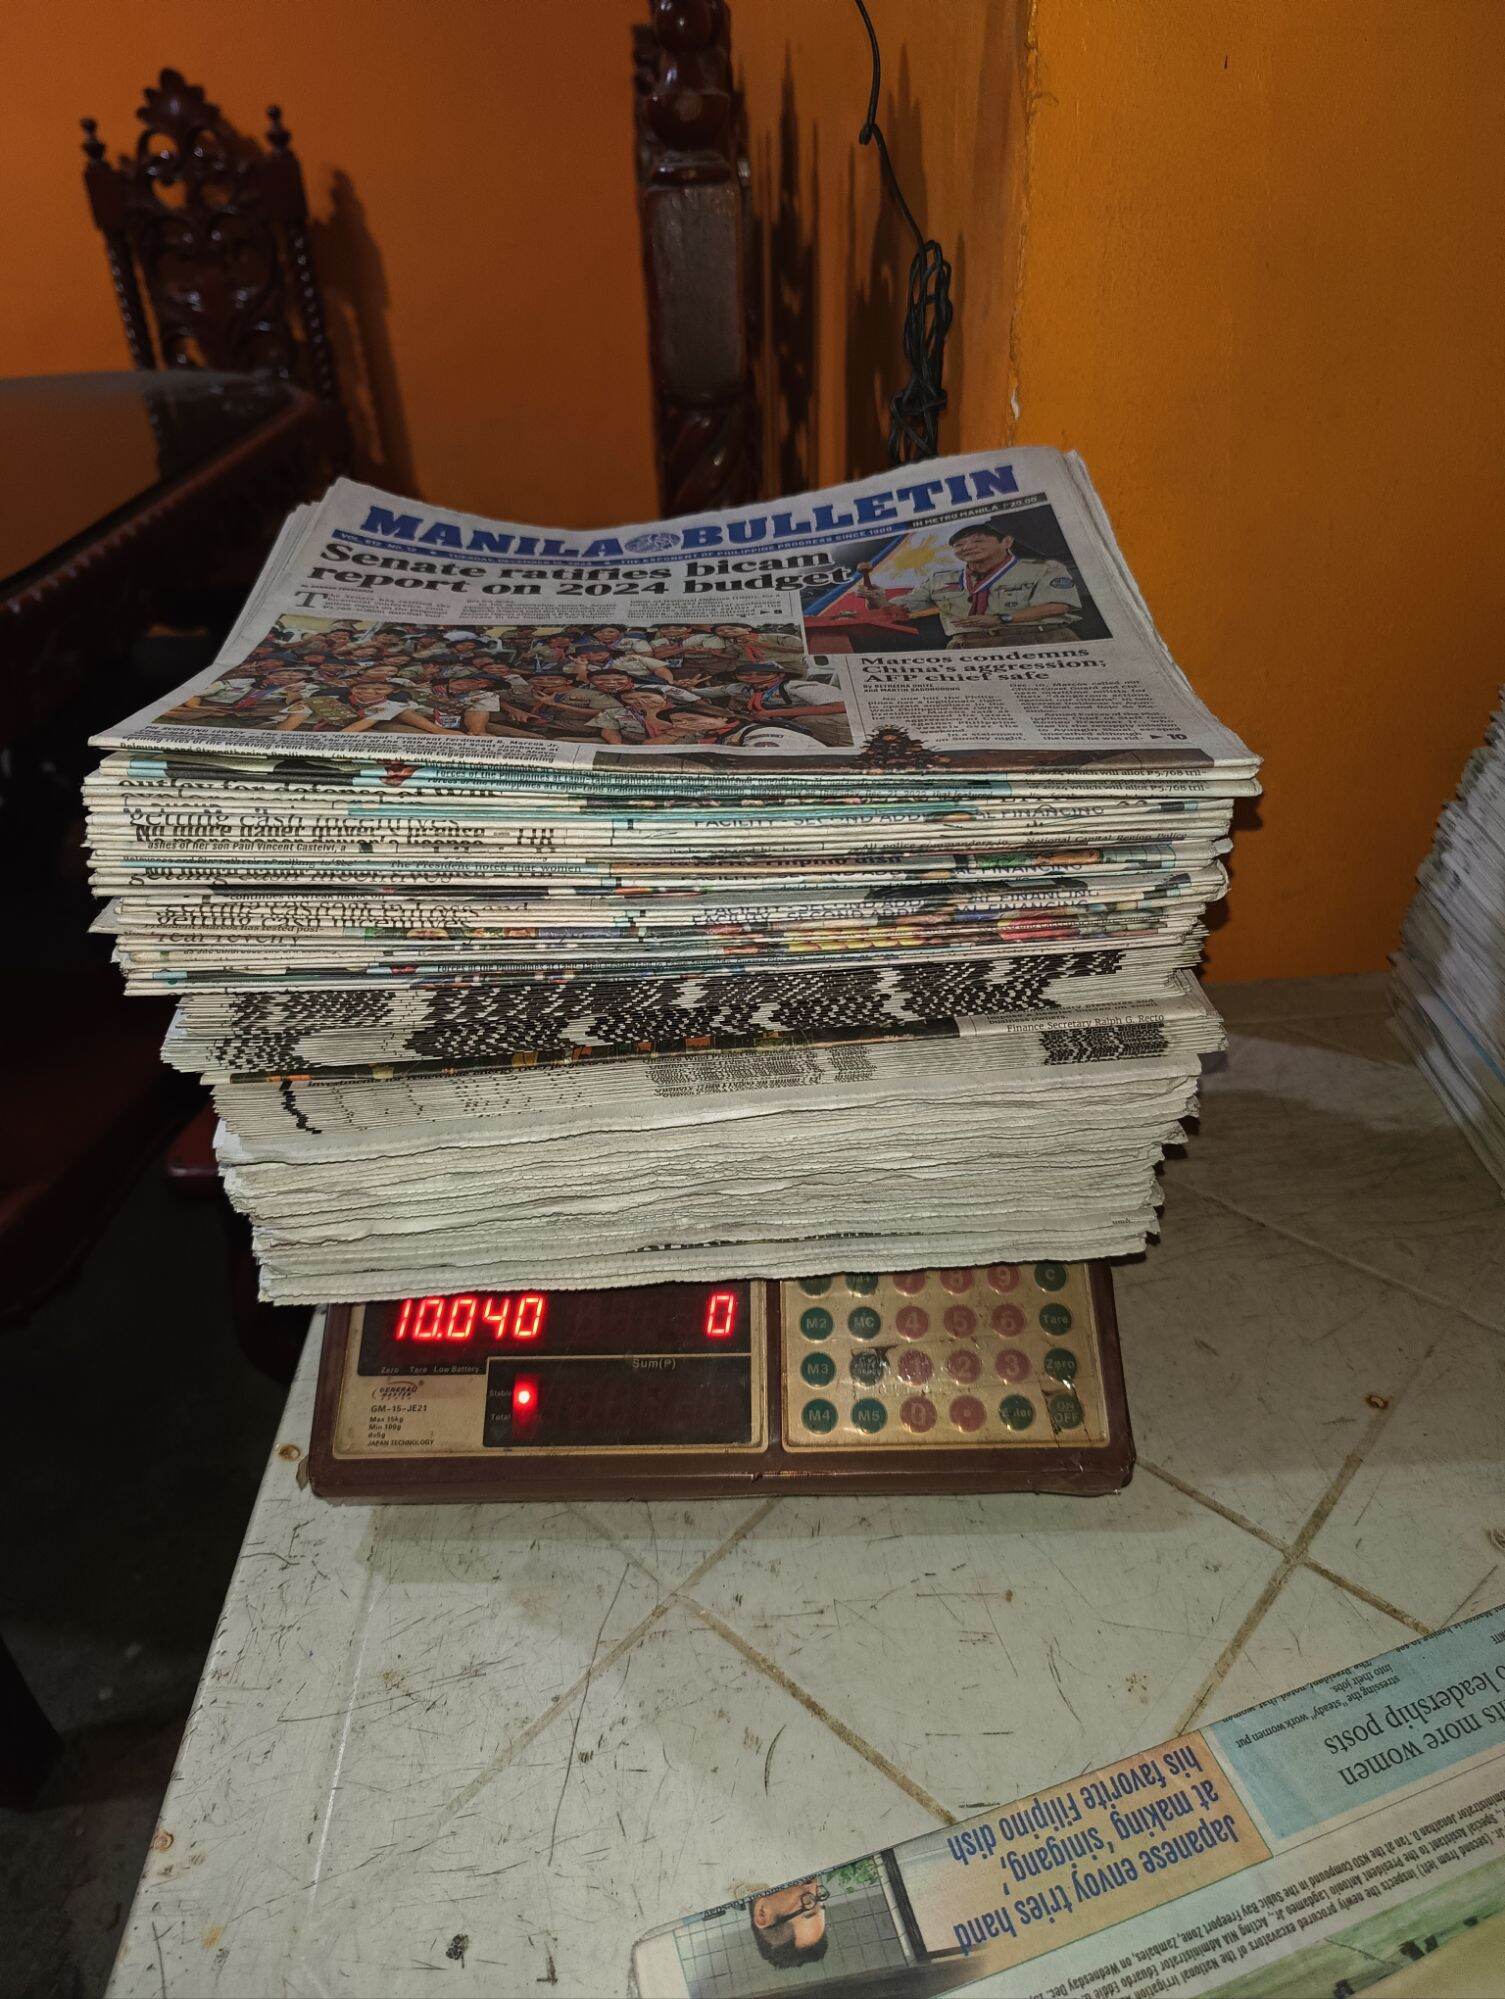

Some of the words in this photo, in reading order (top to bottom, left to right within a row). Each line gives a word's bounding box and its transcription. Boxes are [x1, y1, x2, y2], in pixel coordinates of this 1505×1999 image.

[361, 506, 623, 558] MANILA
[681, 465, 1018, 550] BULLETIN
[925, 513, 958, 526] METRO
[960, 504, 998, 518] MANILA
[717, 545, 775, 557] PHILIPPINE
[778, 537, 832, 550] PROGRESS
[320, 543, 487, 577] Senate
[500, 567, 671, 581] ratifies
[686, 552, 833, 577] bicam
[308, 566, 470, 592] report
[482, 584, 542, 595] on
[556, 581, 668, 597] 2024
[683, 567, 853, 593] budget
[861, 656, 952, 665] Marcos
[959, 648, 1089, 662] condemns
[862, 664, 957, 673] China's
[963, 659, 1106, 673] aggression;
[866, 674, 917, 682] AFP
[925, 672, 992, 681] chief
[998, 671, 1049, 681] safe
[1166, 733, 1188, 741] 10
[1000, 806, 1105, 818] FINANCING
[193, 841, 209, 850] her
[232, 842, 254, 850] Paul
[257, 842, 294, 850] Vincent
[416, 862, 468, 870] President
[475, 863, 507, 871] noted
[512, 864, 537, 872] that
[540, 865, 583, 873] women
[1007, 1023, 1044, 1033] Finance
[1047, 1019, 1092, 1031] Secretary
[1094, 1016, 1122, 1027] Ralph
[1125, 1015, 1136, 1024] G.
[1138, 1014, 1165, 1023] Recto
[1046, 1269, 1056, 1280] C
[395, 1296, 545, 1340] 10.040
[704, 1294, 735, 1338] 0
[806, 1317, 827, 1329] M2
[905, 1310, 920, 1328] 4
[953, 1309, 967, 1329] 5
[807, 1363, 829, 1375] M3
[959, 1357, 972, 1376] 2
[1006, 1355, 1018, 1375] 3
[1045, 1359, 1075, 1370] Zero
[371, 1404, 428, 1413] GM-15-JE21
[808, 1409, 831, 1422] M4
[368, 1423, 383, 1431] Min
[384, 1423, 402, 1432] 100g
[367, 1439, 389, 1448] JAPAN
[390, 1438, 435, 1448] TECHNOLOGY
[1351, 1671, 1374, 1687] their
[1373, 1663, 1393, 1676] into
[1329, 1677, 1353, 1692] jobs.
[1358, 1674, 1400, 1699] stressing
[1345, 1690, 1362, 1705] the
[1384, 1671, 1501, 1729] leadership
[1283, 1713, 1309, 1729] work
[1234, 1733, 1252, 1748] put
[1251, 1721, 1286, 1741] women
[1323, 1712, 1384, 1754] posts
[1422, 1713, 1483, 1749] more
[1162, 1745, 1203, 1778] his
[1337, 1740, 1424, 1785] women
[1079, 1759, 1166, 1810] favorite
[1190, 1779, 1219, 1811] at
[998, 1792, 1082, 1841] Filipino
[1109, 1789, 1194, 1840] making
[1419, 1813, 1457, 1836] Jonathan
[946, 1823, 996, 1865] dish
[1137, 1814, 1239, 1873] Japanese
[1393, 1834, 1412, 1847] Tan
[1408, 1829, 1422, 1844] D.
[1427, 1826, 1468, 1851] Assistant
[1457, 1832, 1494, 1857] (second
[1368, 1845, 1386, 1859] the
[1383, 1840, 1395, 1854] at
[1402, 1849, 1420, 1862] the
[1417, 1844, 1430, 1855] to
[1436, 1848, 1460, 1865] from
[1351, 1852, 1372, 1868] NSD
[1361, 1855, 1405, 1881] President
[1415, 1858, 1439, 1877] left)
[1071, 1857, 1138, 1903] envoy
[1307, 1860, 1354, 1888] Compound
[1379, 1868, 1419, 1891] inspects
[1282, 1884, 1300, 1897] the
[1297, 1879, 1310, 1891] in
[1328, 1874, 1363, 1895] Antonio
[1363, 1884, 1382, 1898] the
[1013, 1884, 1073, 1924] tries
[1240, 1901, 1260, 1917] Bay
[1257, 1890, 1284, 1909] Subic
[1284, 1888, 1330, 1915] Lagdameo
[1336, 1891, 1364, 1910] newly
[1201, 1909, 1243, 1935] Freeport
[1237, 1915, 1268, 1936] Acting
[1296, 1901, 1338, 1931] procured
[952, 1906, 1017, 1956] hand
[1176, 1925, 1204, 1942] Zone,
[1221, 1929, 1240, 1945] NIA
[1247, 1922, 1296, 1951] excavators
[1131, 1936, 1179, 1962] Zambales,
[1159, 1936, 1222, 1971] Administrator
[1219, 1949, 1237, 1963] the
[1236, 1944, 1248, 1959] of
[1118, 1956, 1132, 1969] on
[1179, 1957, 1220, 1983] National
[1067, 1962, 1121, 1991] Wednesday
[1120, 1964, 1159, 1988] Eduardo
